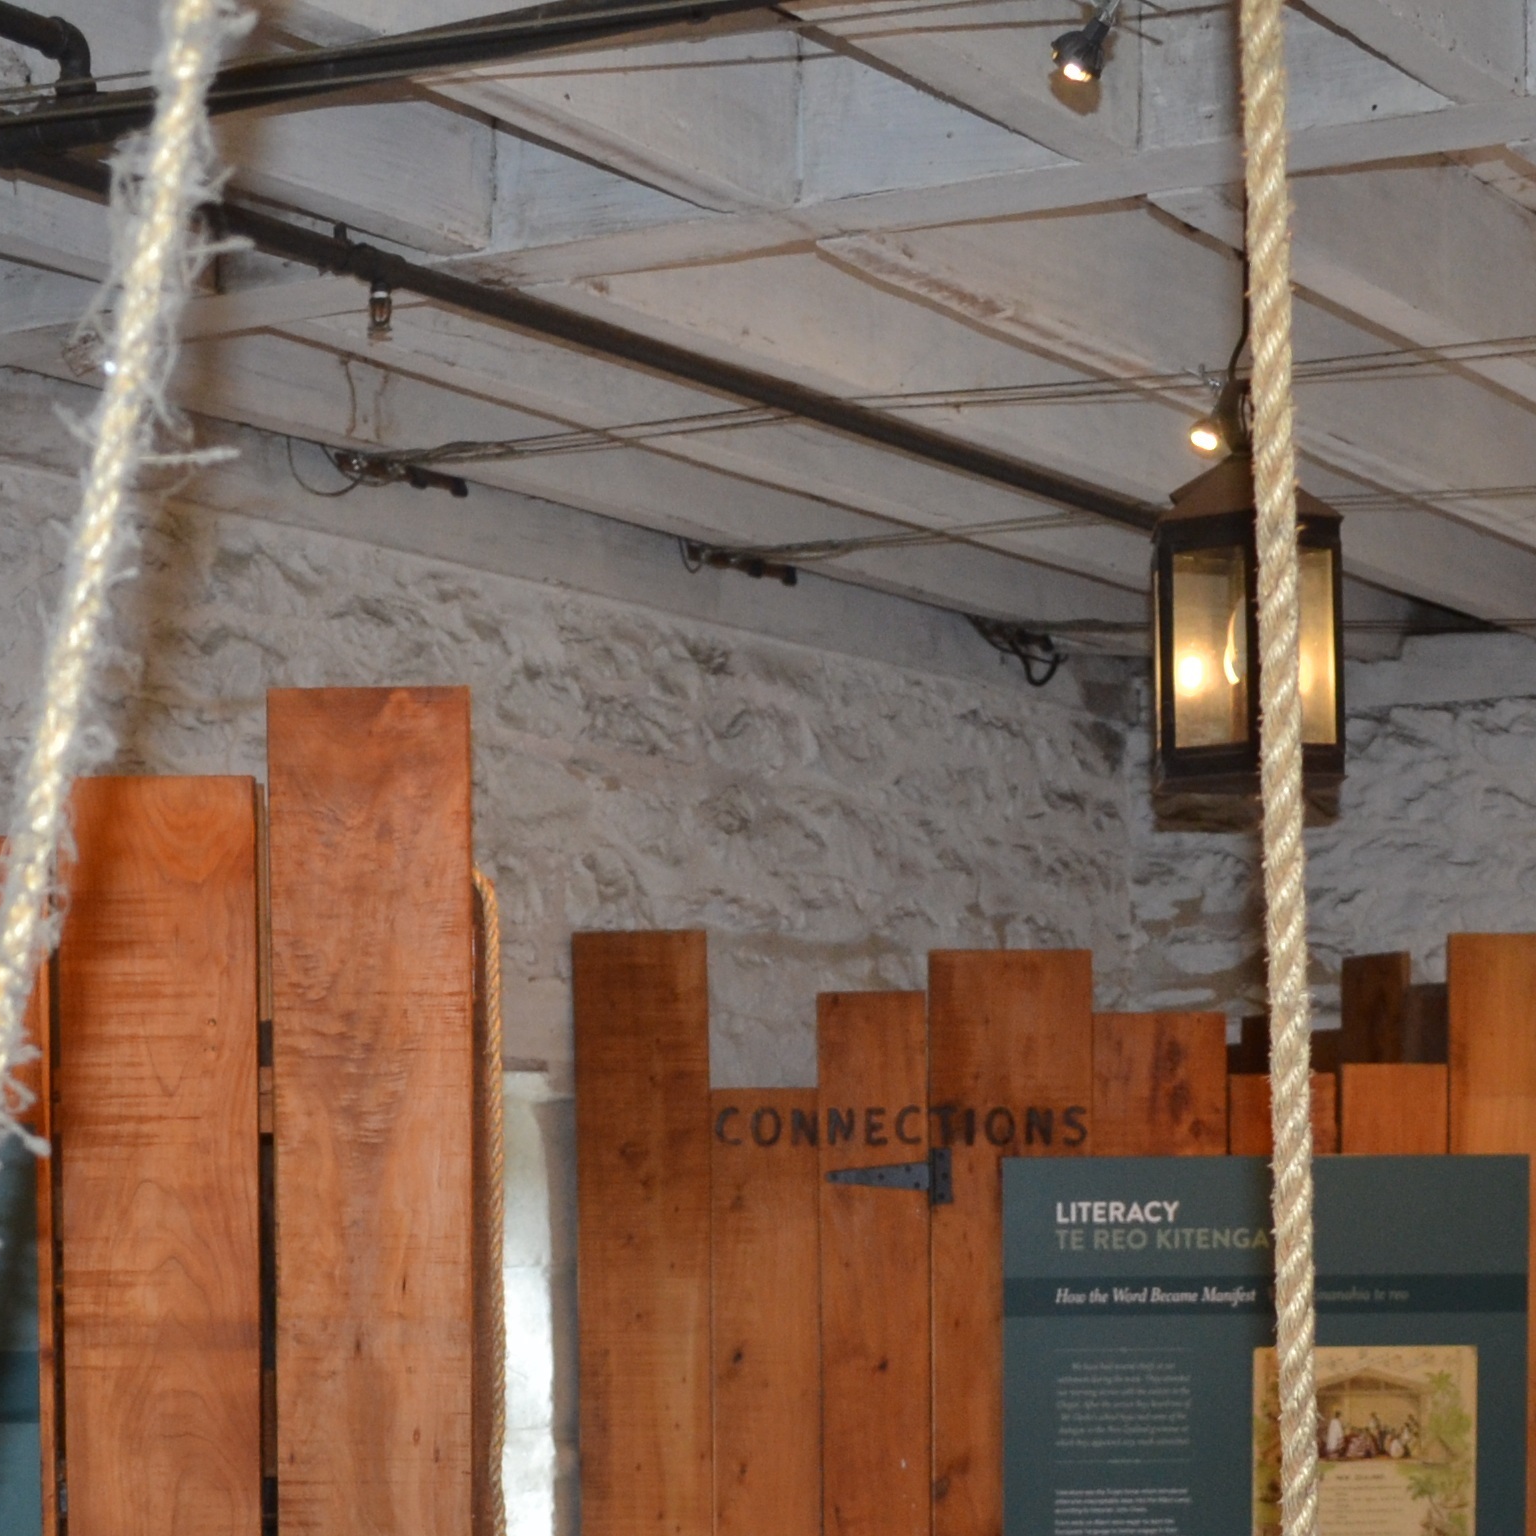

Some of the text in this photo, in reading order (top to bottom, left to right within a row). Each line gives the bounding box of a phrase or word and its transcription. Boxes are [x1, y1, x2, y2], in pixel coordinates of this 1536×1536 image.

[715, 1106, 1088, 1147] CONNECTIONS
[1057, 1201, 1178, 1223] LITERACY
[1056, 1229, 1083, 1250] TE
[1094, 1229, 1147, 1249] REO
[1056, 1287, 1255, 1306] How the Word Became Manifest
